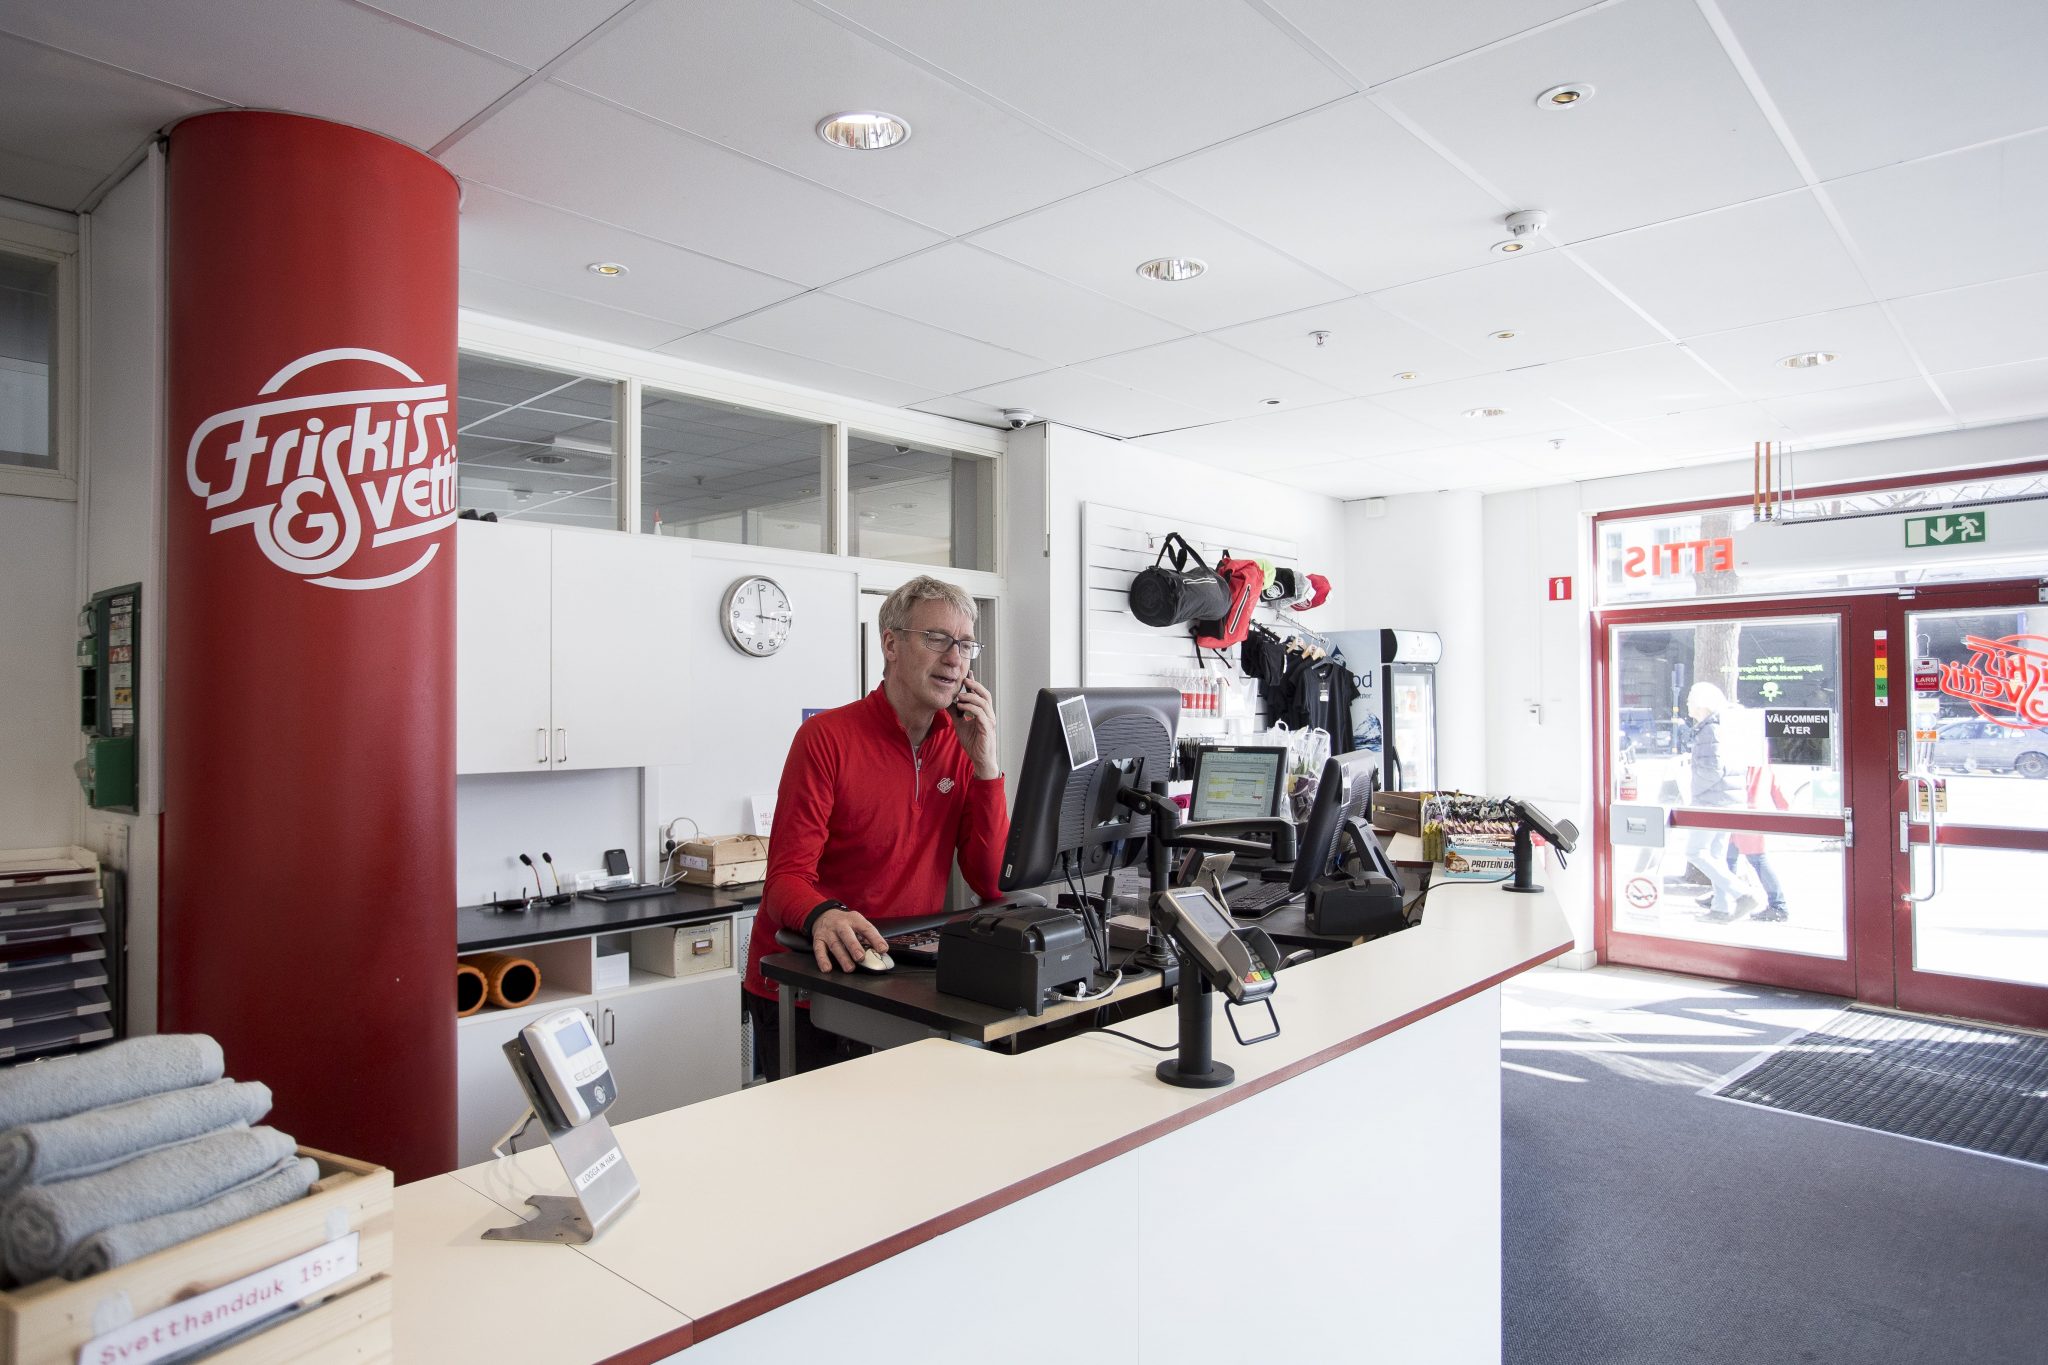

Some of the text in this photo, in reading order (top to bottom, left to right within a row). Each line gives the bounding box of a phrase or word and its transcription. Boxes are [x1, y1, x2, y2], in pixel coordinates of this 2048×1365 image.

[187, 384, 449, 511] Friskis
[778, 601, 784, 609] 2
[733, 610, 740, 619] 9
[781, 615, 788, 623] 3
[746, 637, 751, 645] 7
[757, 642, 764, 650] 6
[1766, 713, 1828, 724] VÄLKOMMEN
[1782, 724, 1811, 735] ÅTER
[1471, 860, 1514, 869] PROTEIN BA
[583, 1166, 601, 1184] LOGGA
[99, 1254, 346, 1365] Svetthandduk 15:-
